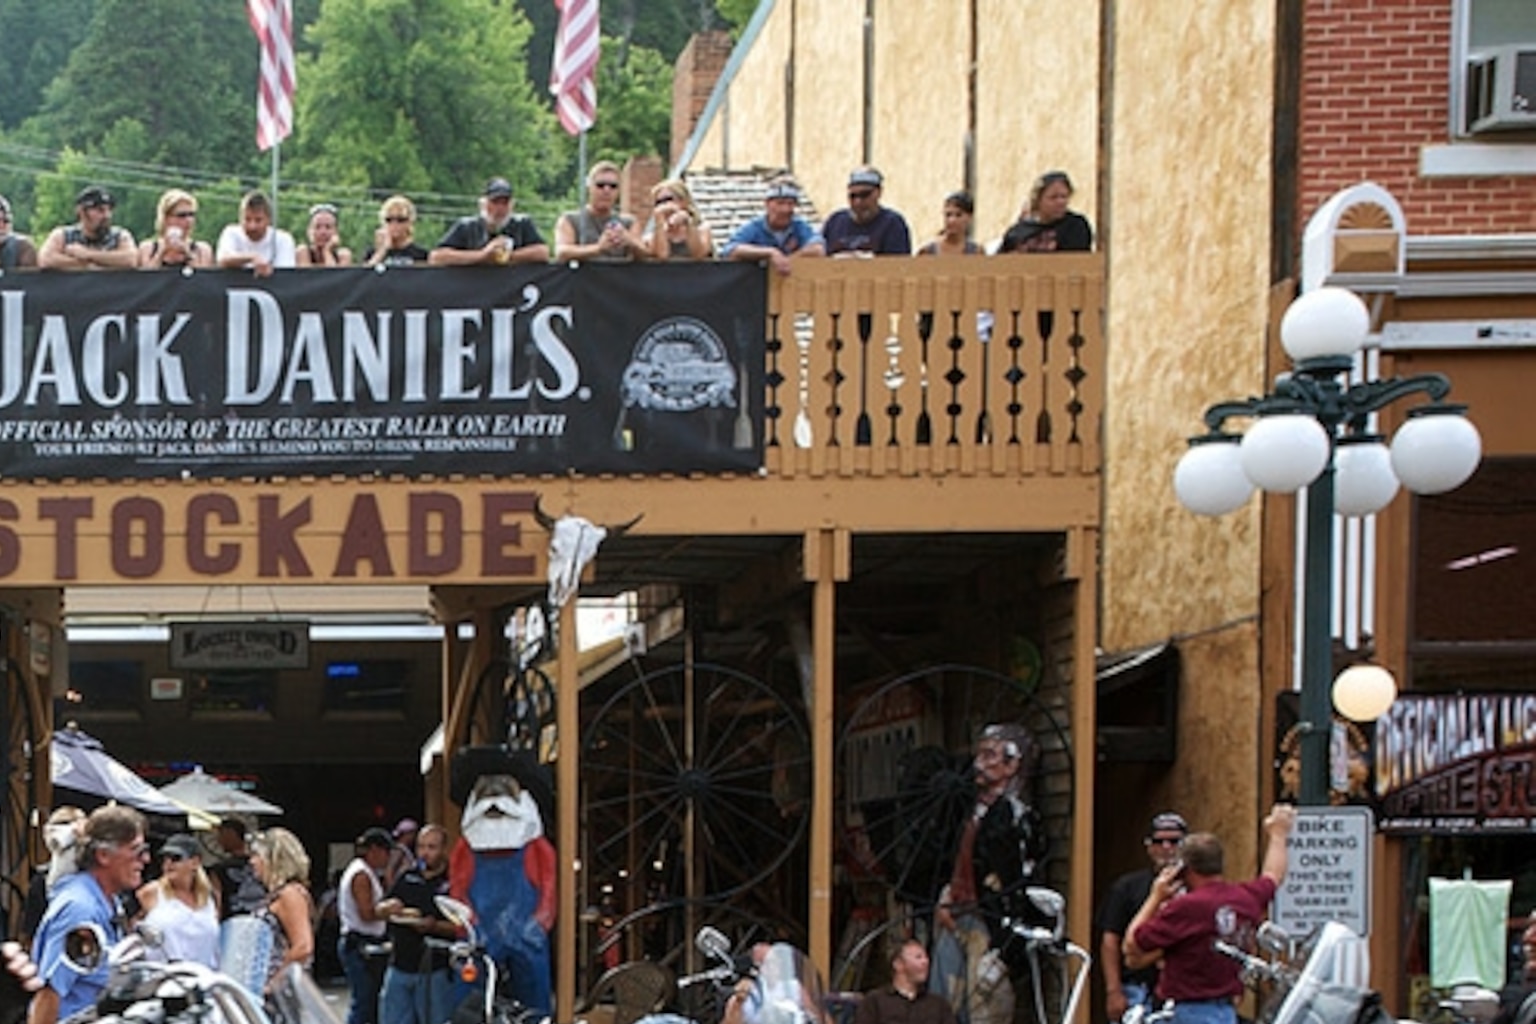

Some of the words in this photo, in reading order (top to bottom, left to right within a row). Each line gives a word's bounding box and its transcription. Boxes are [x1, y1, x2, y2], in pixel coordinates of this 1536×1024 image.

[89, 418, 187, 440] SPONSOR
[190, 418, 221, 439] OF
[225, 418, 270, 439] THE
[271, 416, 383, 439] GREATEST
[385, 415, 454, 437] RALLY
[456, 415, 490, 436] ON
[492, 414, 567, 436] EARTH
[33, 442, 73, 456] YOUR
[156, 441, 193, 457] JACK
[260, 439, 317, 455] REMIND
[318, 439, 352, 454] YOU
[352, 438, 373, 452] TO
[374, 437, 423, 452] DRINK
[1297, 820, 1345, 833] BIKE
[1286, 836, 1358, 850] PARKING
[1300, 853, 1342, 867] ONLY
[1289, 871, 1319, 881] THIS
[1324, 871, 1353, 881] SIDE
[1287, 884, 1303, 894] OF
[1308, 883, 1354, 894] STREET
